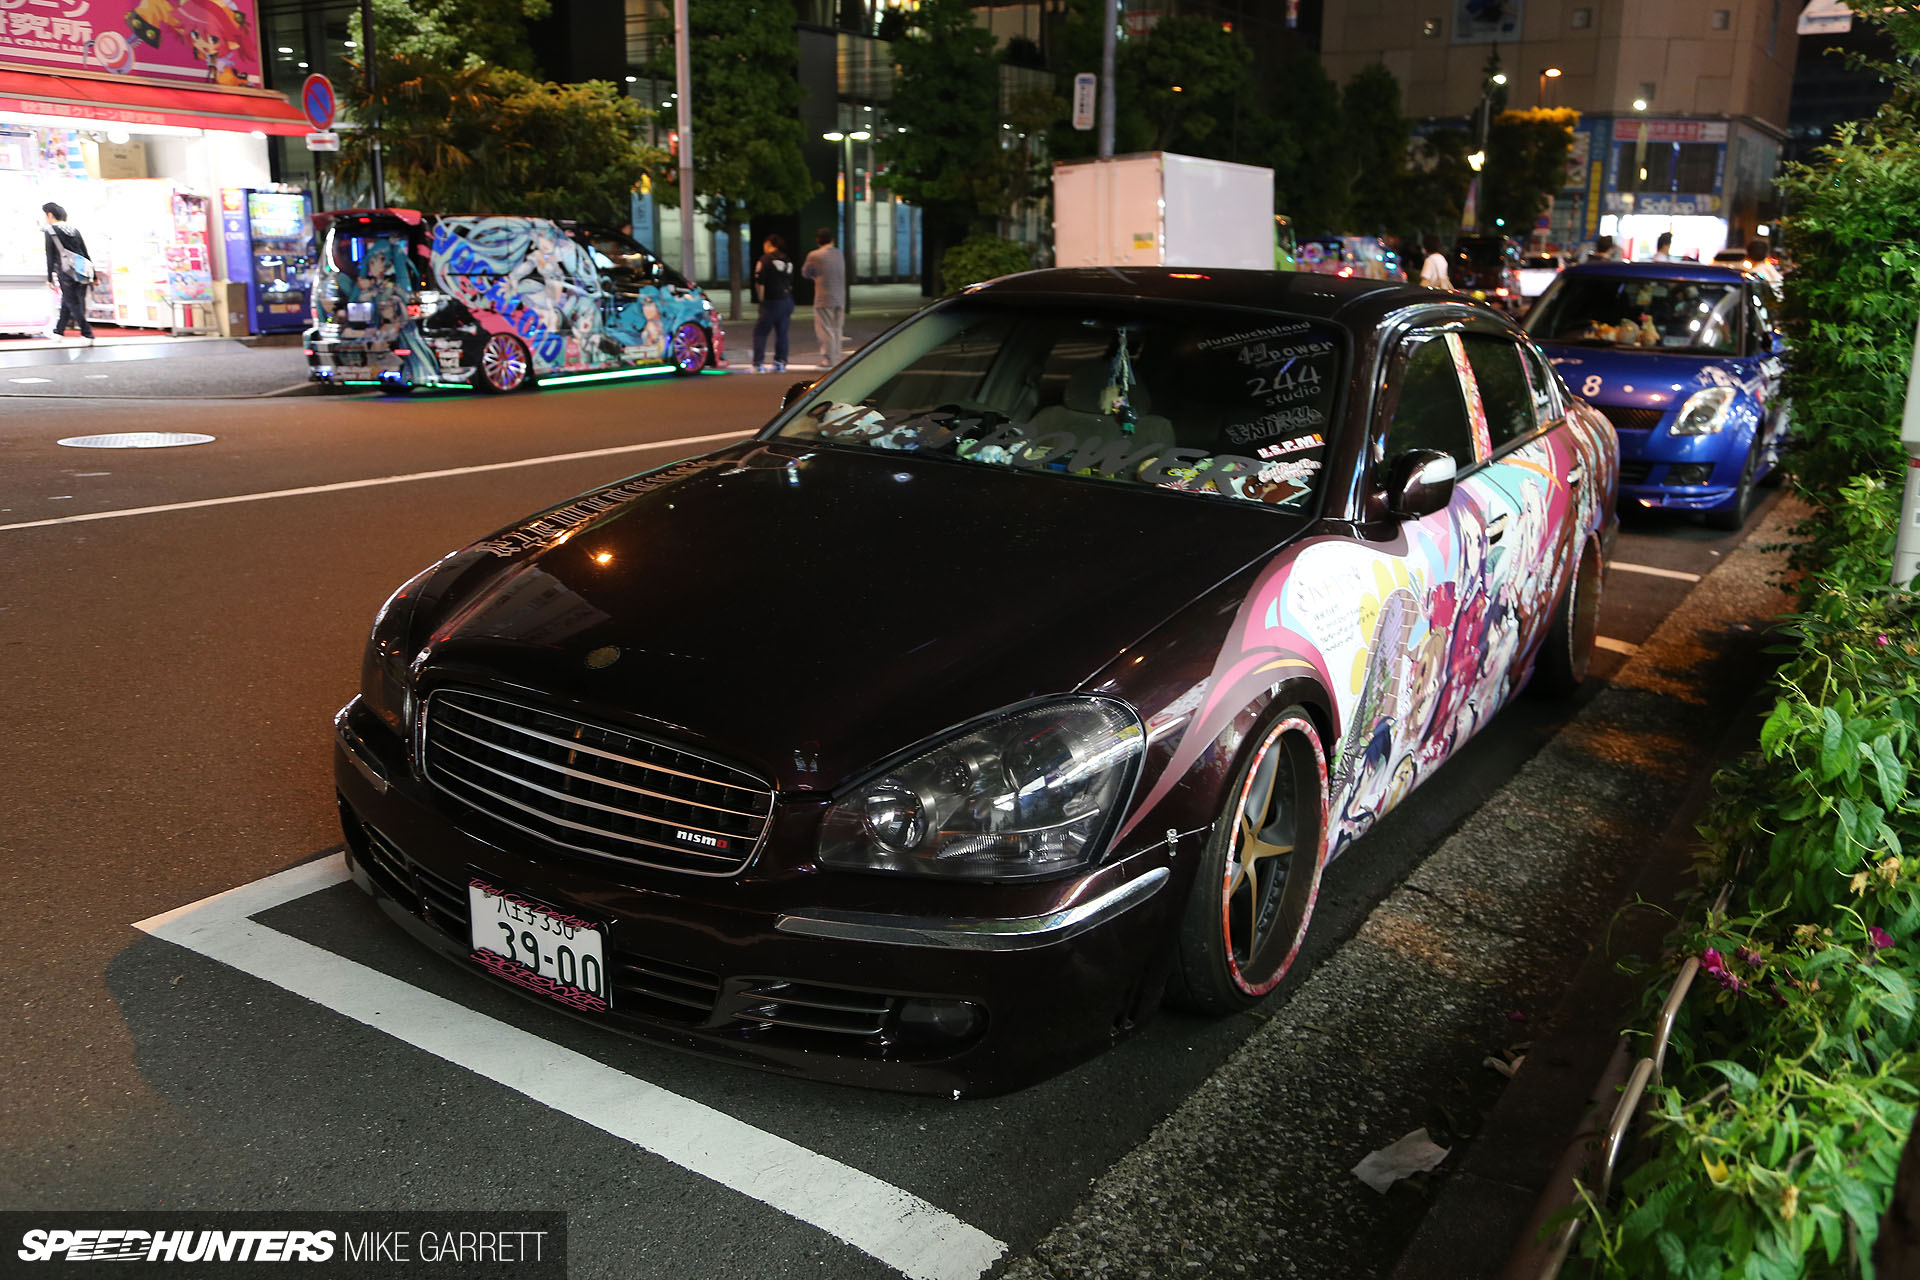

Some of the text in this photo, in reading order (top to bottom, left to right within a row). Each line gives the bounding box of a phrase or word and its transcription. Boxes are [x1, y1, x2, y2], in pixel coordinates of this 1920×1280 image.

[1246, 364, 1322, 396] 244
[1265, 385, 1321, 406] studio
[1582, 375, 1603, 397] 8
[469, 877, 505, 897] Total
[504, 893, 535, 909] Car
[497, 921, 602, 997] 39-00
